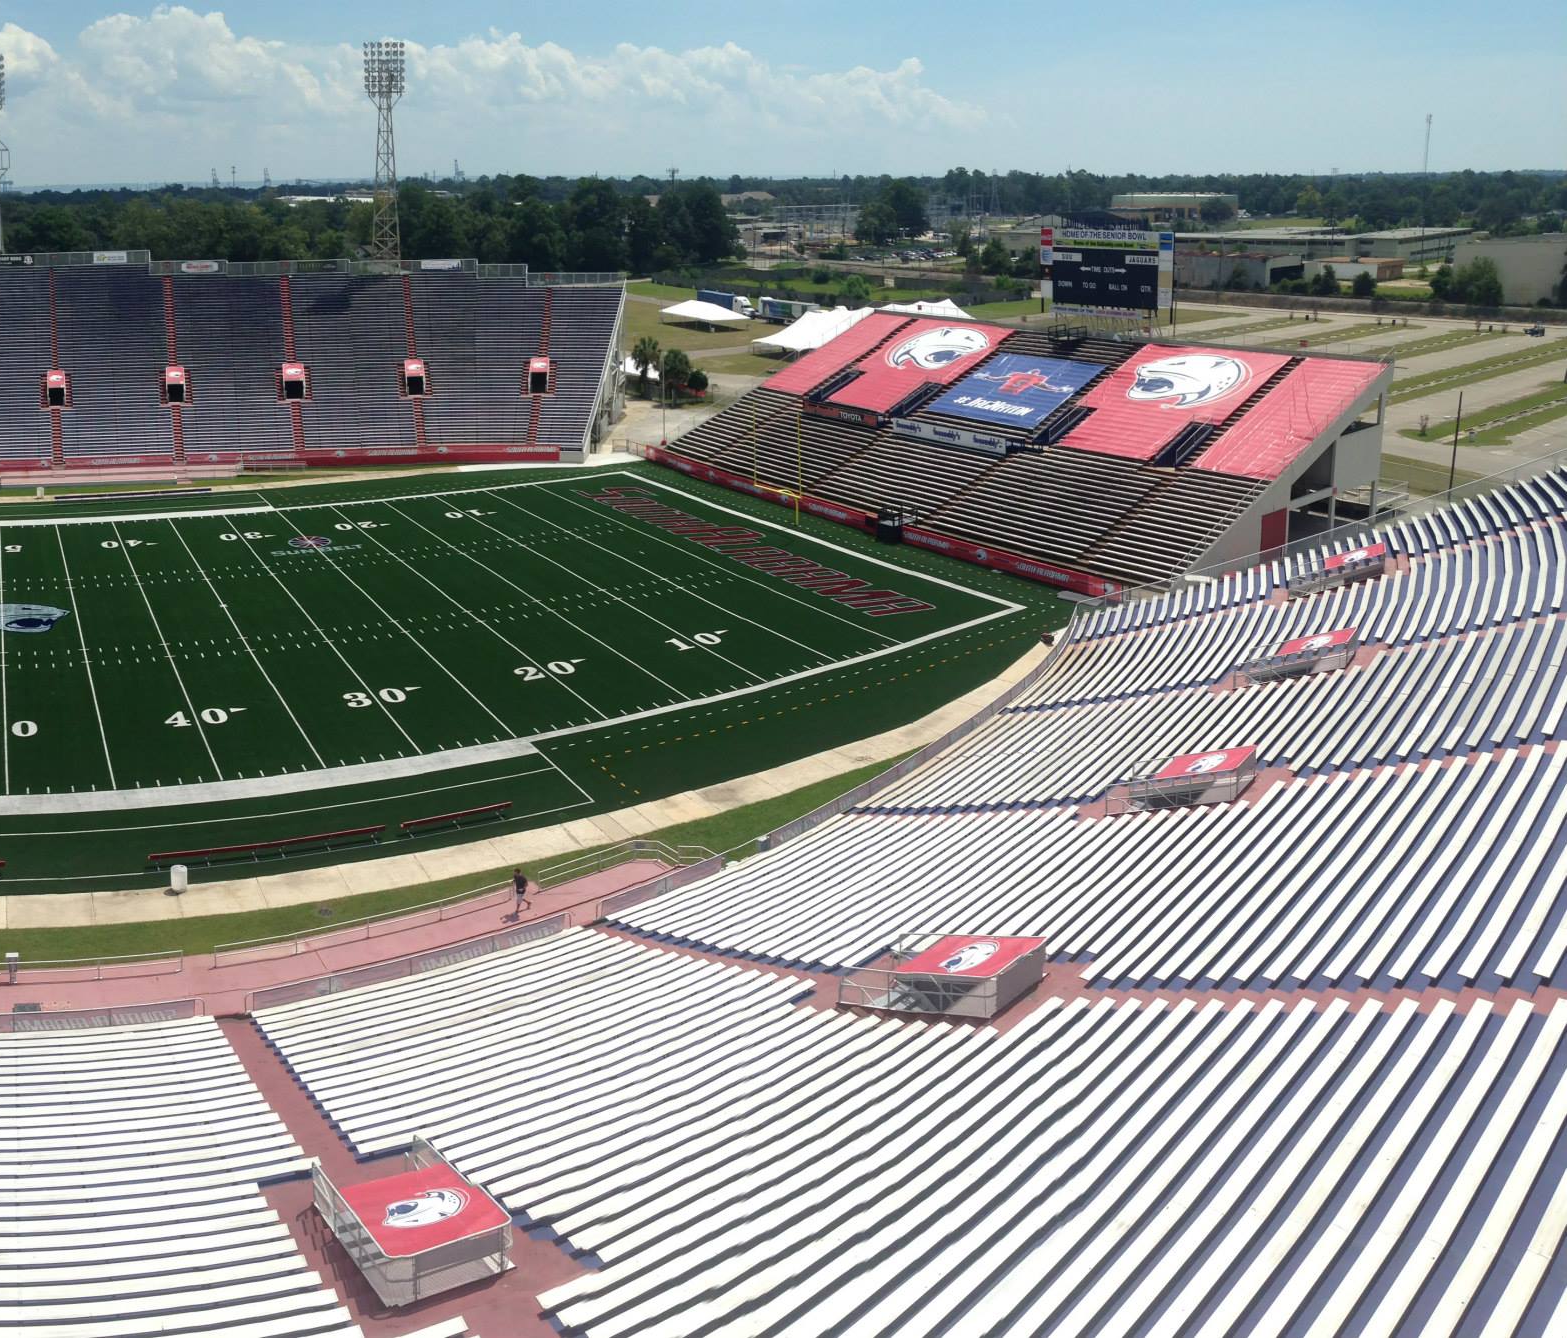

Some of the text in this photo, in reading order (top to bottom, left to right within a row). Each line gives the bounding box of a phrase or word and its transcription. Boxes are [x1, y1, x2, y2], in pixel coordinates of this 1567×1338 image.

[1128, 232, 1147, 240] BOWL
[1128, 256, 1156, 264] JAGUARS
[840, 412, 862, 422] TOYOTA
[665, 633, 722, 651] 10
[513, 661, 576, 682] 20
[342, 687, 407, 708] 30
[164, 708, 228, 727] 40
